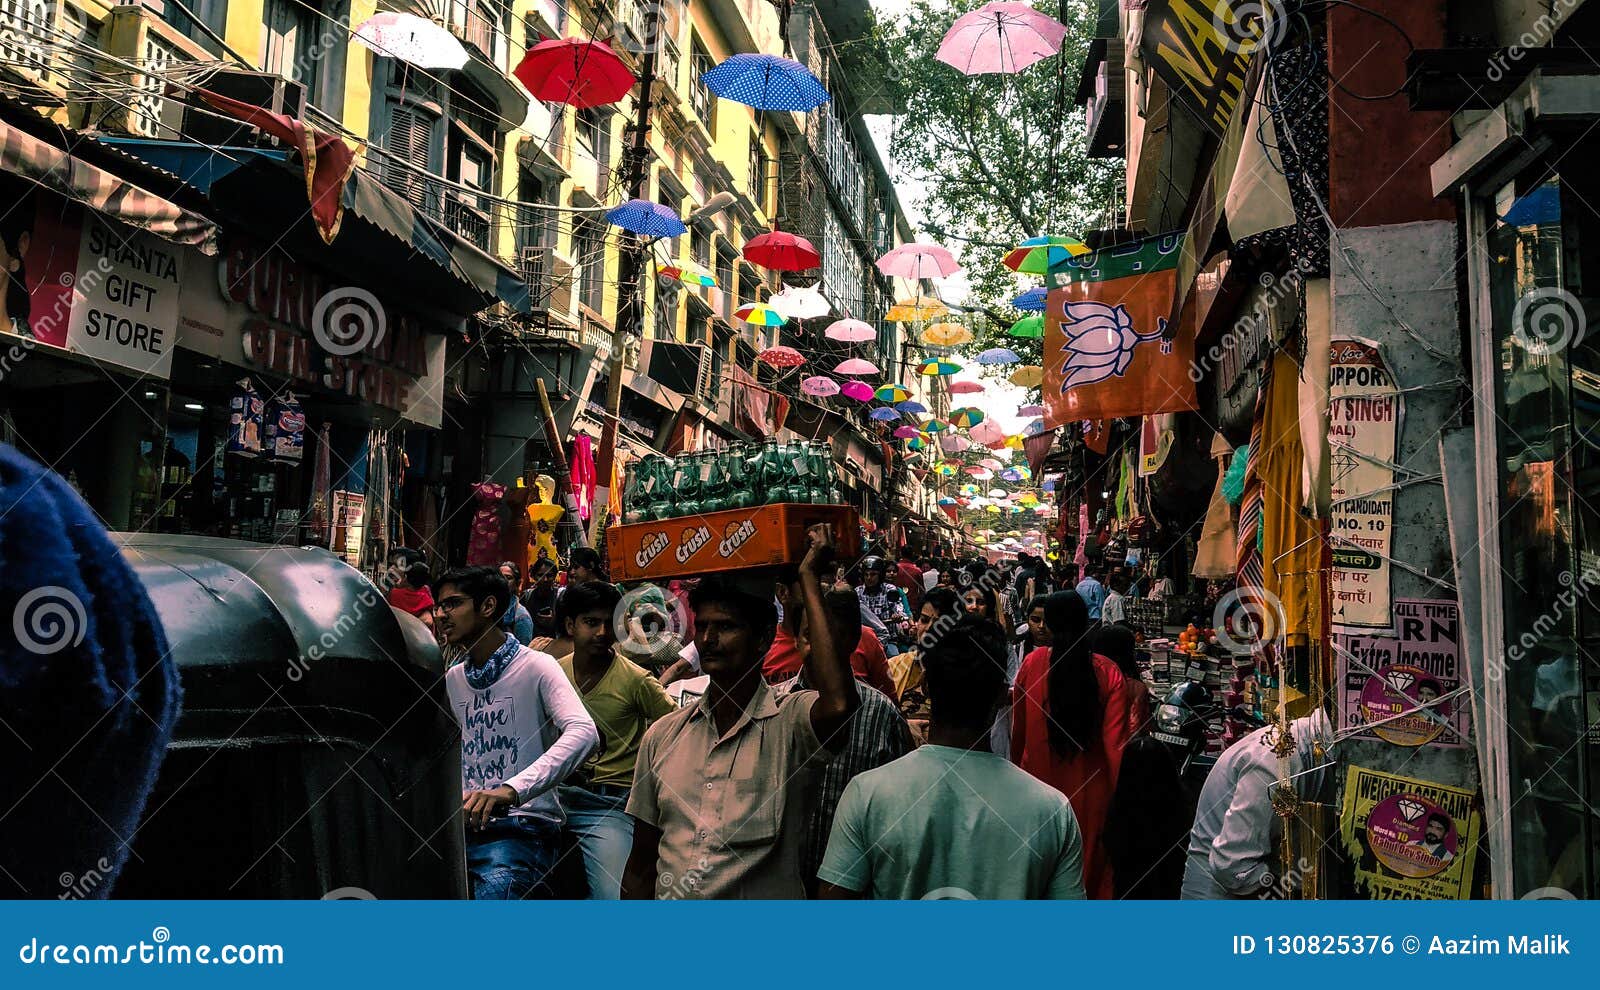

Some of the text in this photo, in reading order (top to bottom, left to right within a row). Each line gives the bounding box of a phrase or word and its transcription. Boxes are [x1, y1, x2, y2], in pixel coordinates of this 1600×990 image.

[1157, 0, 1238, 109] NA
[89, 226, 177, 283] SHANTA
[105, 274, 156, 312] GIFT
[86, 309, 163, 354] STORE
[1330, 367, 1388, 386] UPPORT
[1345, 397, 1393, 422] SINGH
[1338, 518, 1384, 531] NO. 10
[635, 519, 757, 568] Crush Crush Crush
[1423, 605, 1457, 619] TIME
[1403, 618, 1458, 644] RN
[1350, 639, 1455, 677] Extra Income
[474, 689, 495, 711] we
[1391, 703, 1402, 713] 10
[465, 702, 509, 730] have
[1397, 831, 1409, 843] 10
